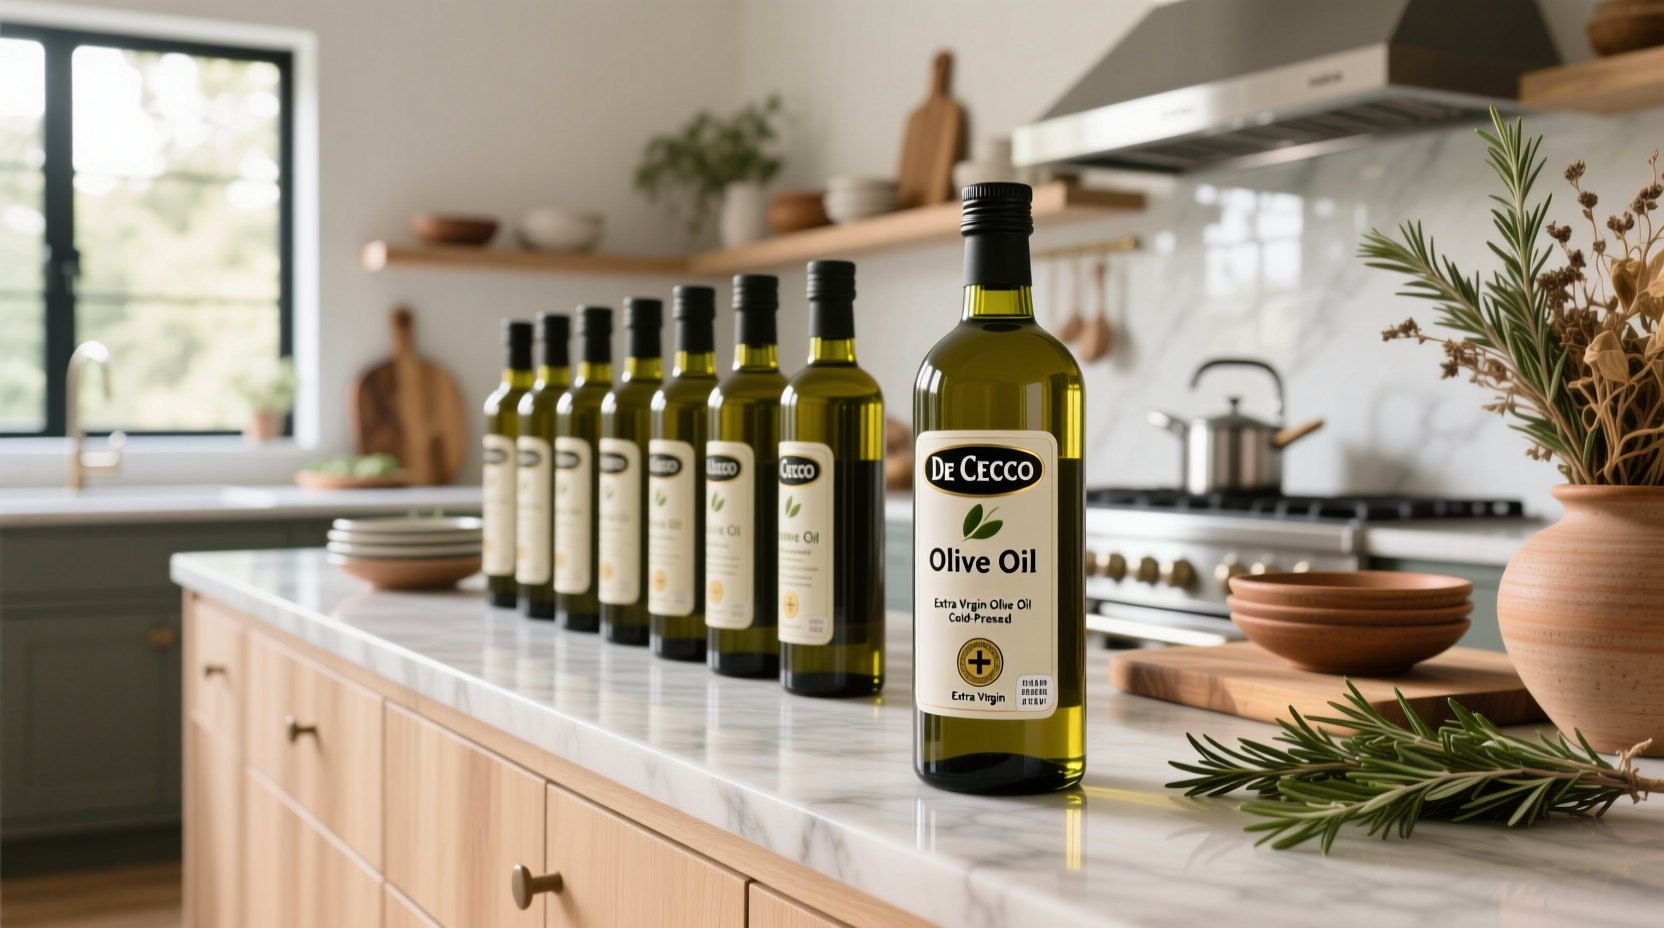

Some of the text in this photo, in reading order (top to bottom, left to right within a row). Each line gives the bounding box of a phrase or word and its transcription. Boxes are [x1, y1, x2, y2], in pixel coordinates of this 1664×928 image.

[929, 547, 1037, 574] Olive Oil
[1016, 598, 1032, 610] Oil
